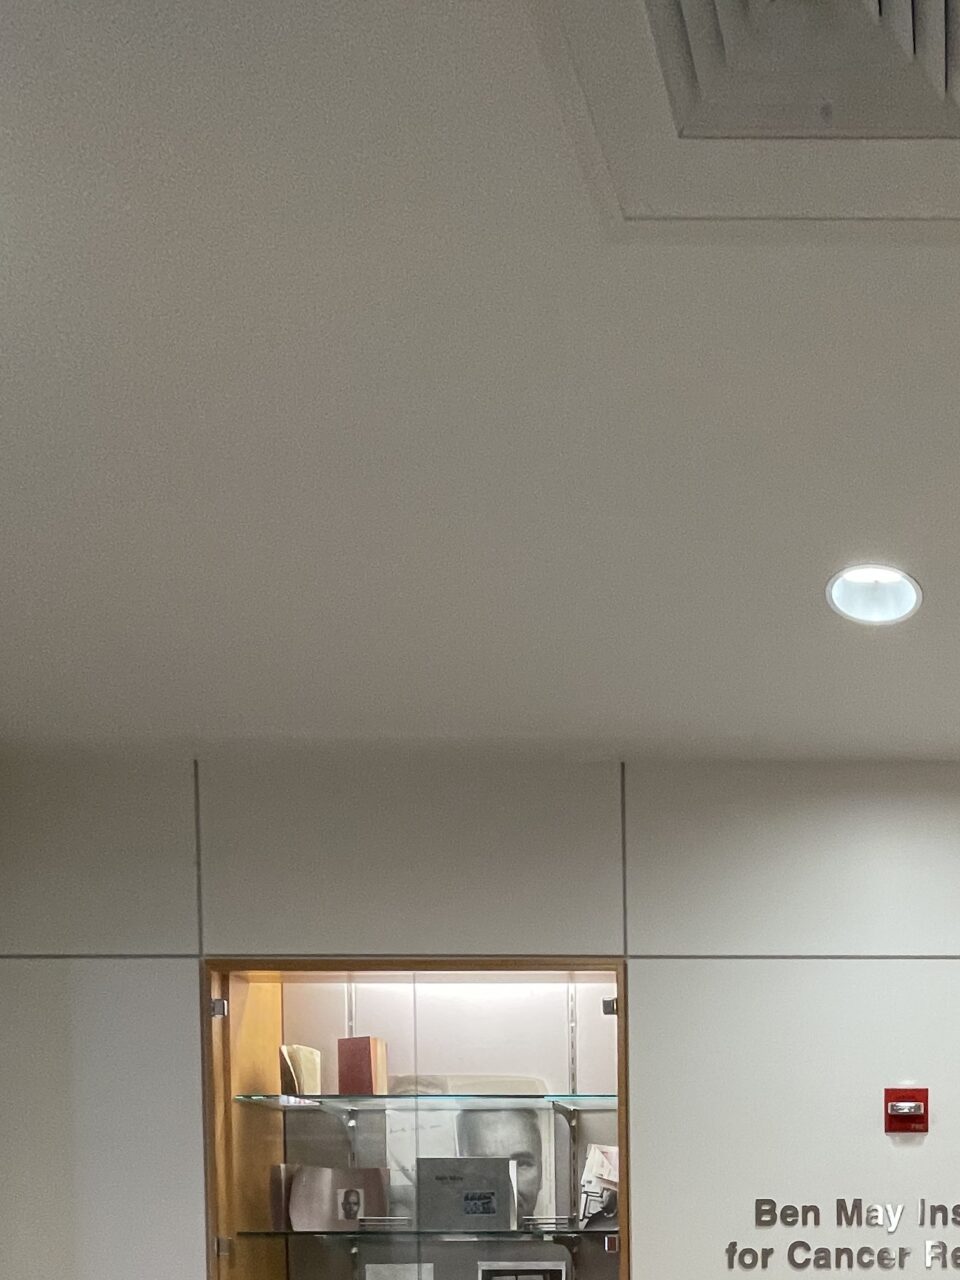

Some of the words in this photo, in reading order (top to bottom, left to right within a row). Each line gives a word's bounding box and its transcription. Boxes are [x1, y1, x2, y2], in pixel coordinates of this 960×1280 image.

[755, 1199, 820, 1226] Ben
[836, 1199, 904, 1232] May
[726, 1241, 774, 1269] for
[788, 1241, 911, 1269] Cancer
